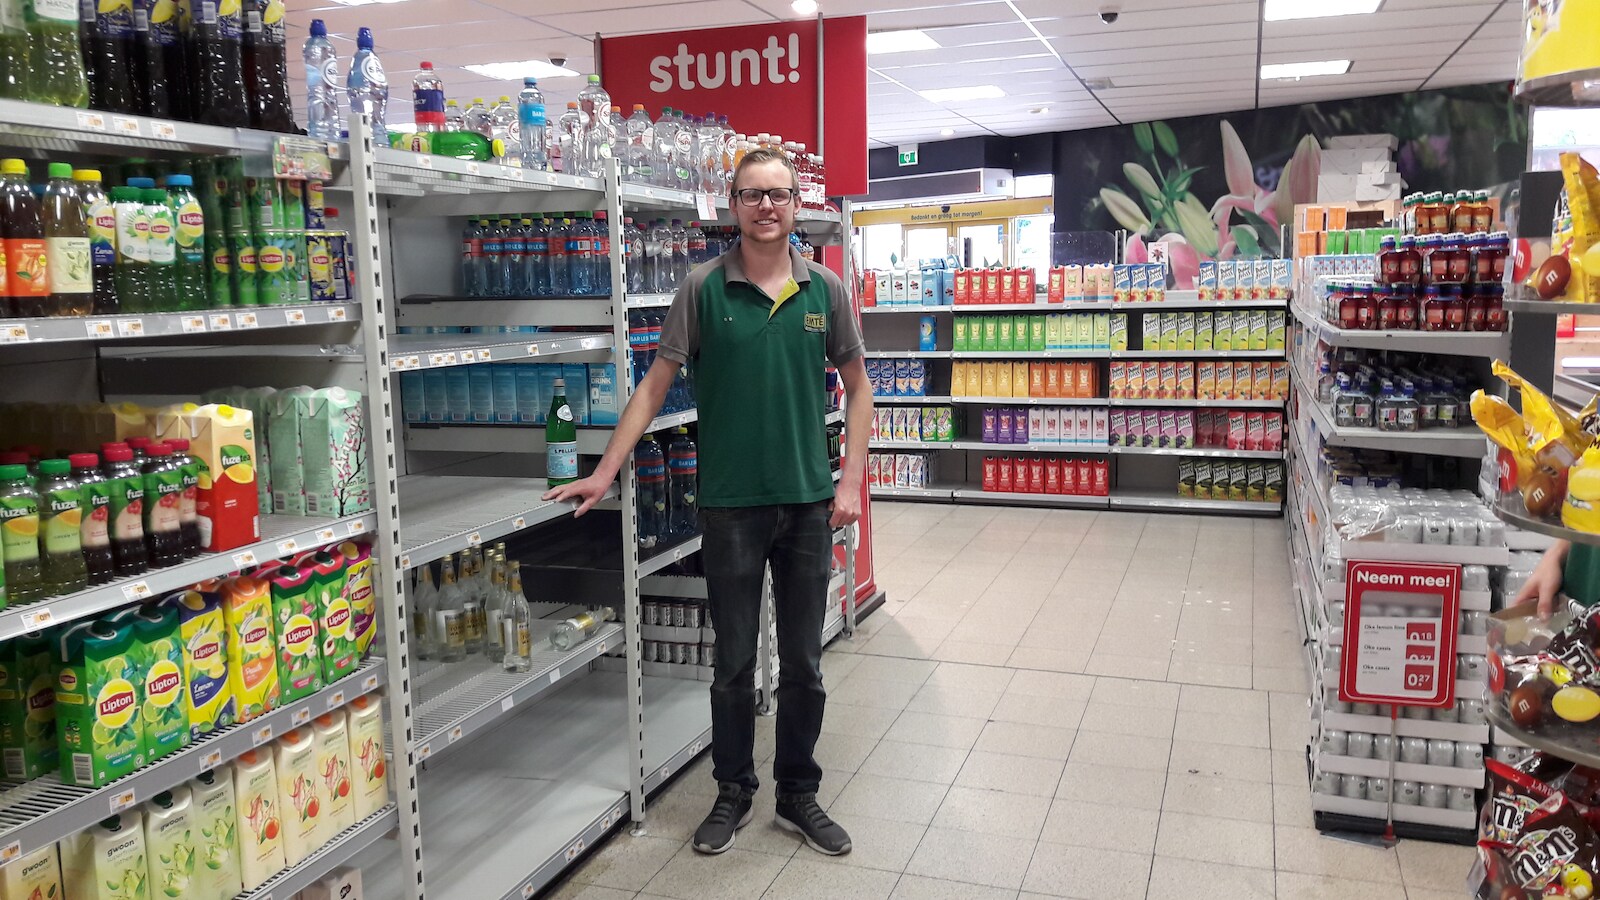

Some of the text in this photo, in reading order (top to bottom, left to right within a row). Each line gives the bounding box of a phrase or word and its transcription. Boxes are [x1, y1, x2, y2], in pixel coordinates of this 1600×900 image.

[650, 33, 800, 92] stunt!
[591, 377, 611, 385] DRINK
[1357, 570, 1450, 587] Neem mee!
[353, 586, 371, 599] Lipton
[329, 610, 349, 625] Lipton
[246, 629, 265, 642] Lipton
[287, 628, 311, 642] Lipton
[195, 644, 217, 658] Lipton
[150, 676, 177, 693] Lipton
[102, 695, 131, 713] Lipton
[107, 840, 135, 857] gwoon
[22, 858, 48, 876] gwoon
